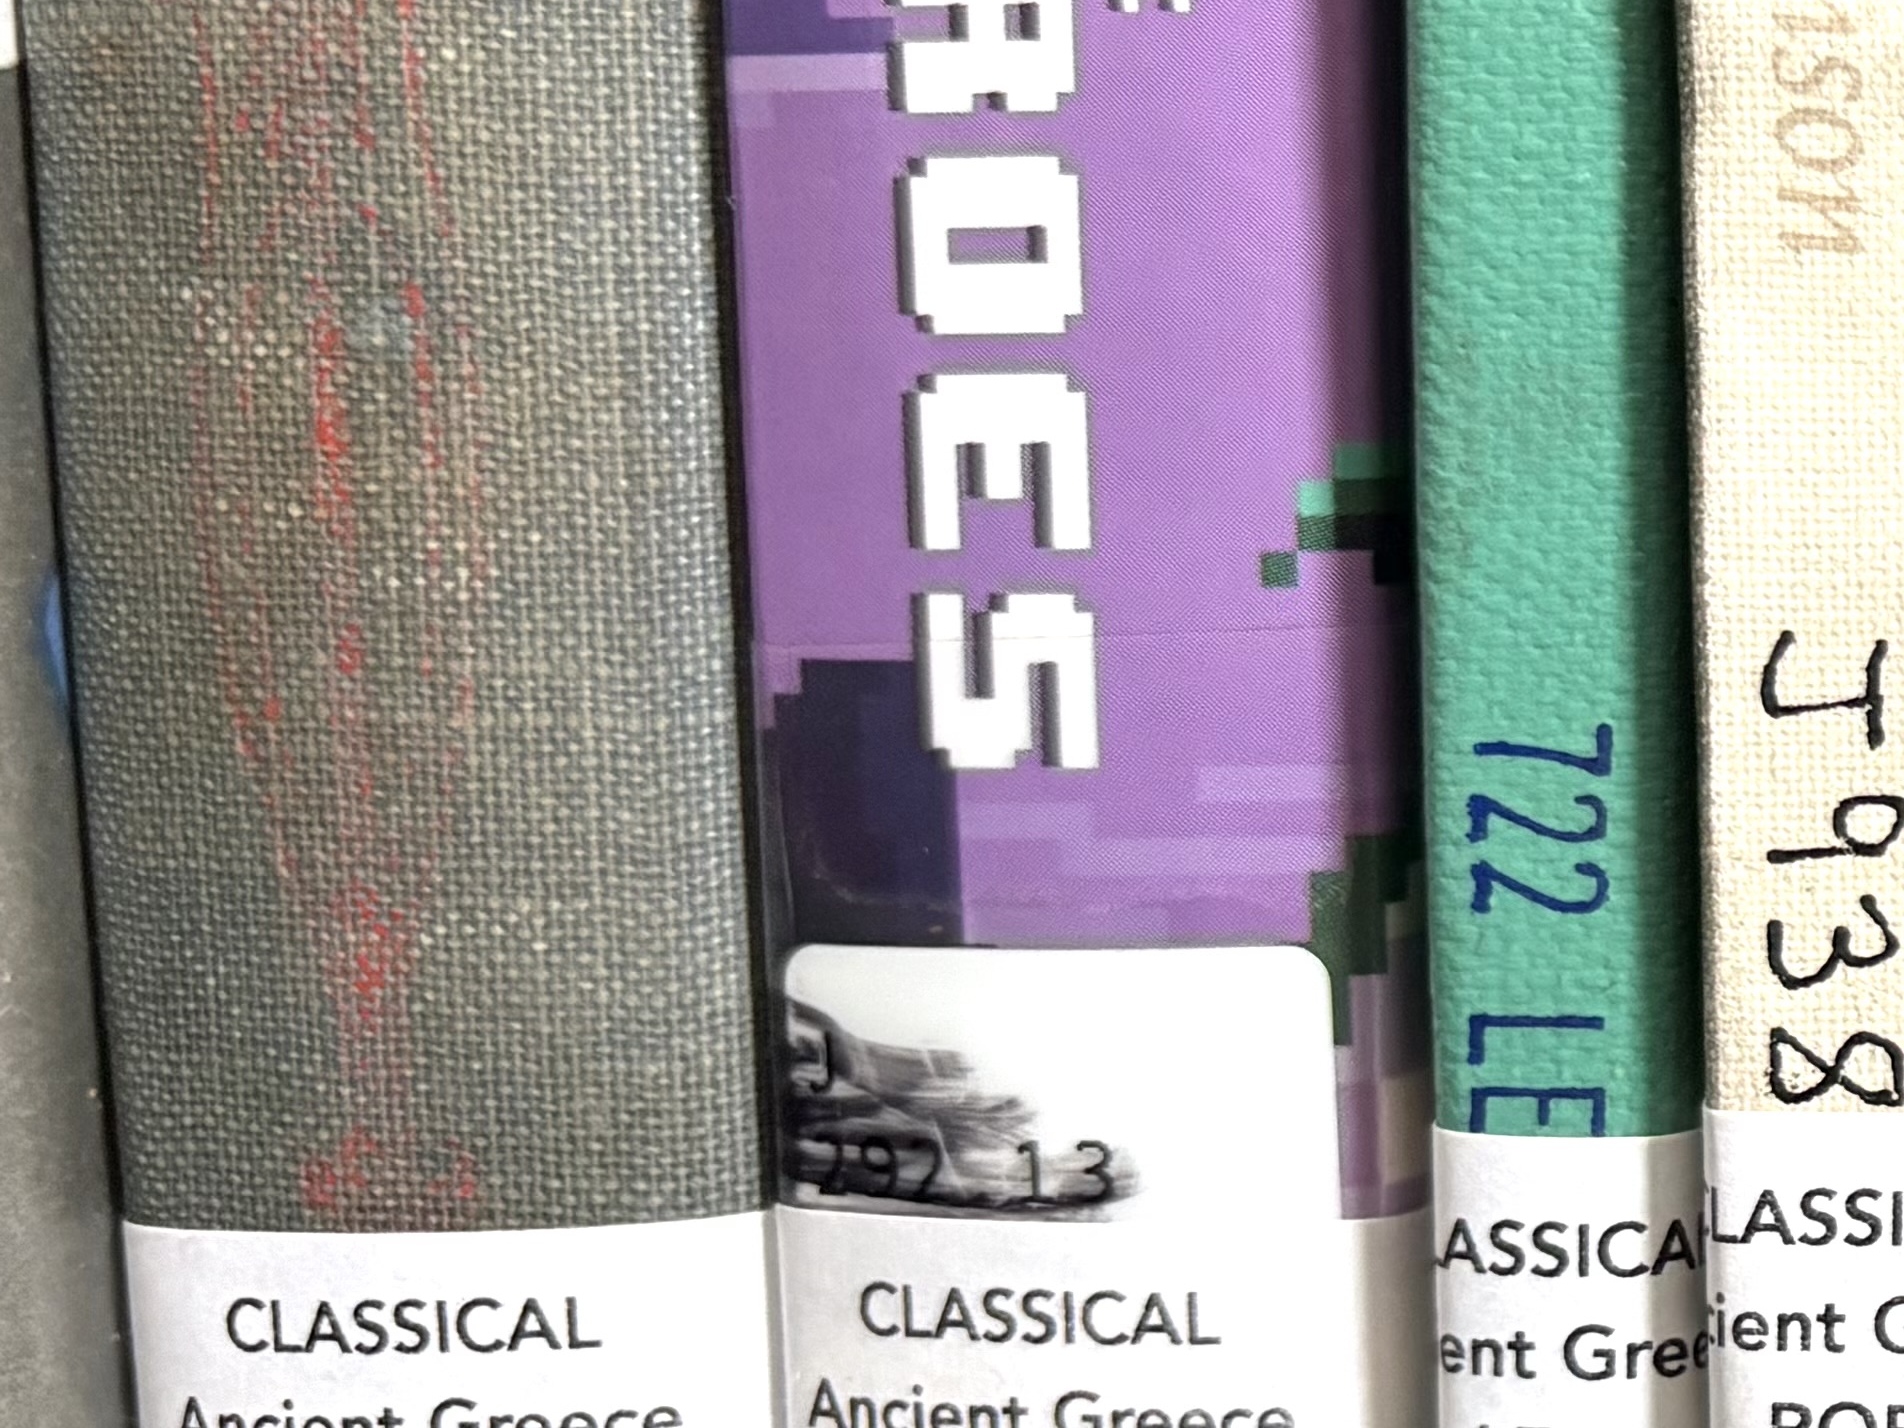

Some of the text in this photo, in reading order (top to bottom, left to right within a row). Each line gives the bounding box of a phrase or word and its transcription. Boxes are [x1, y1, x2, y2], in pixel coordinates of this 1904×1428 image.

[1466, 722, 1613, 914] 722
[1434, 1217, 1708, 1279] ASSICA
[223, 1295, 603, 1358] CLASSICAL
[857, 1279, 1222, 1348] CLASSICAL
